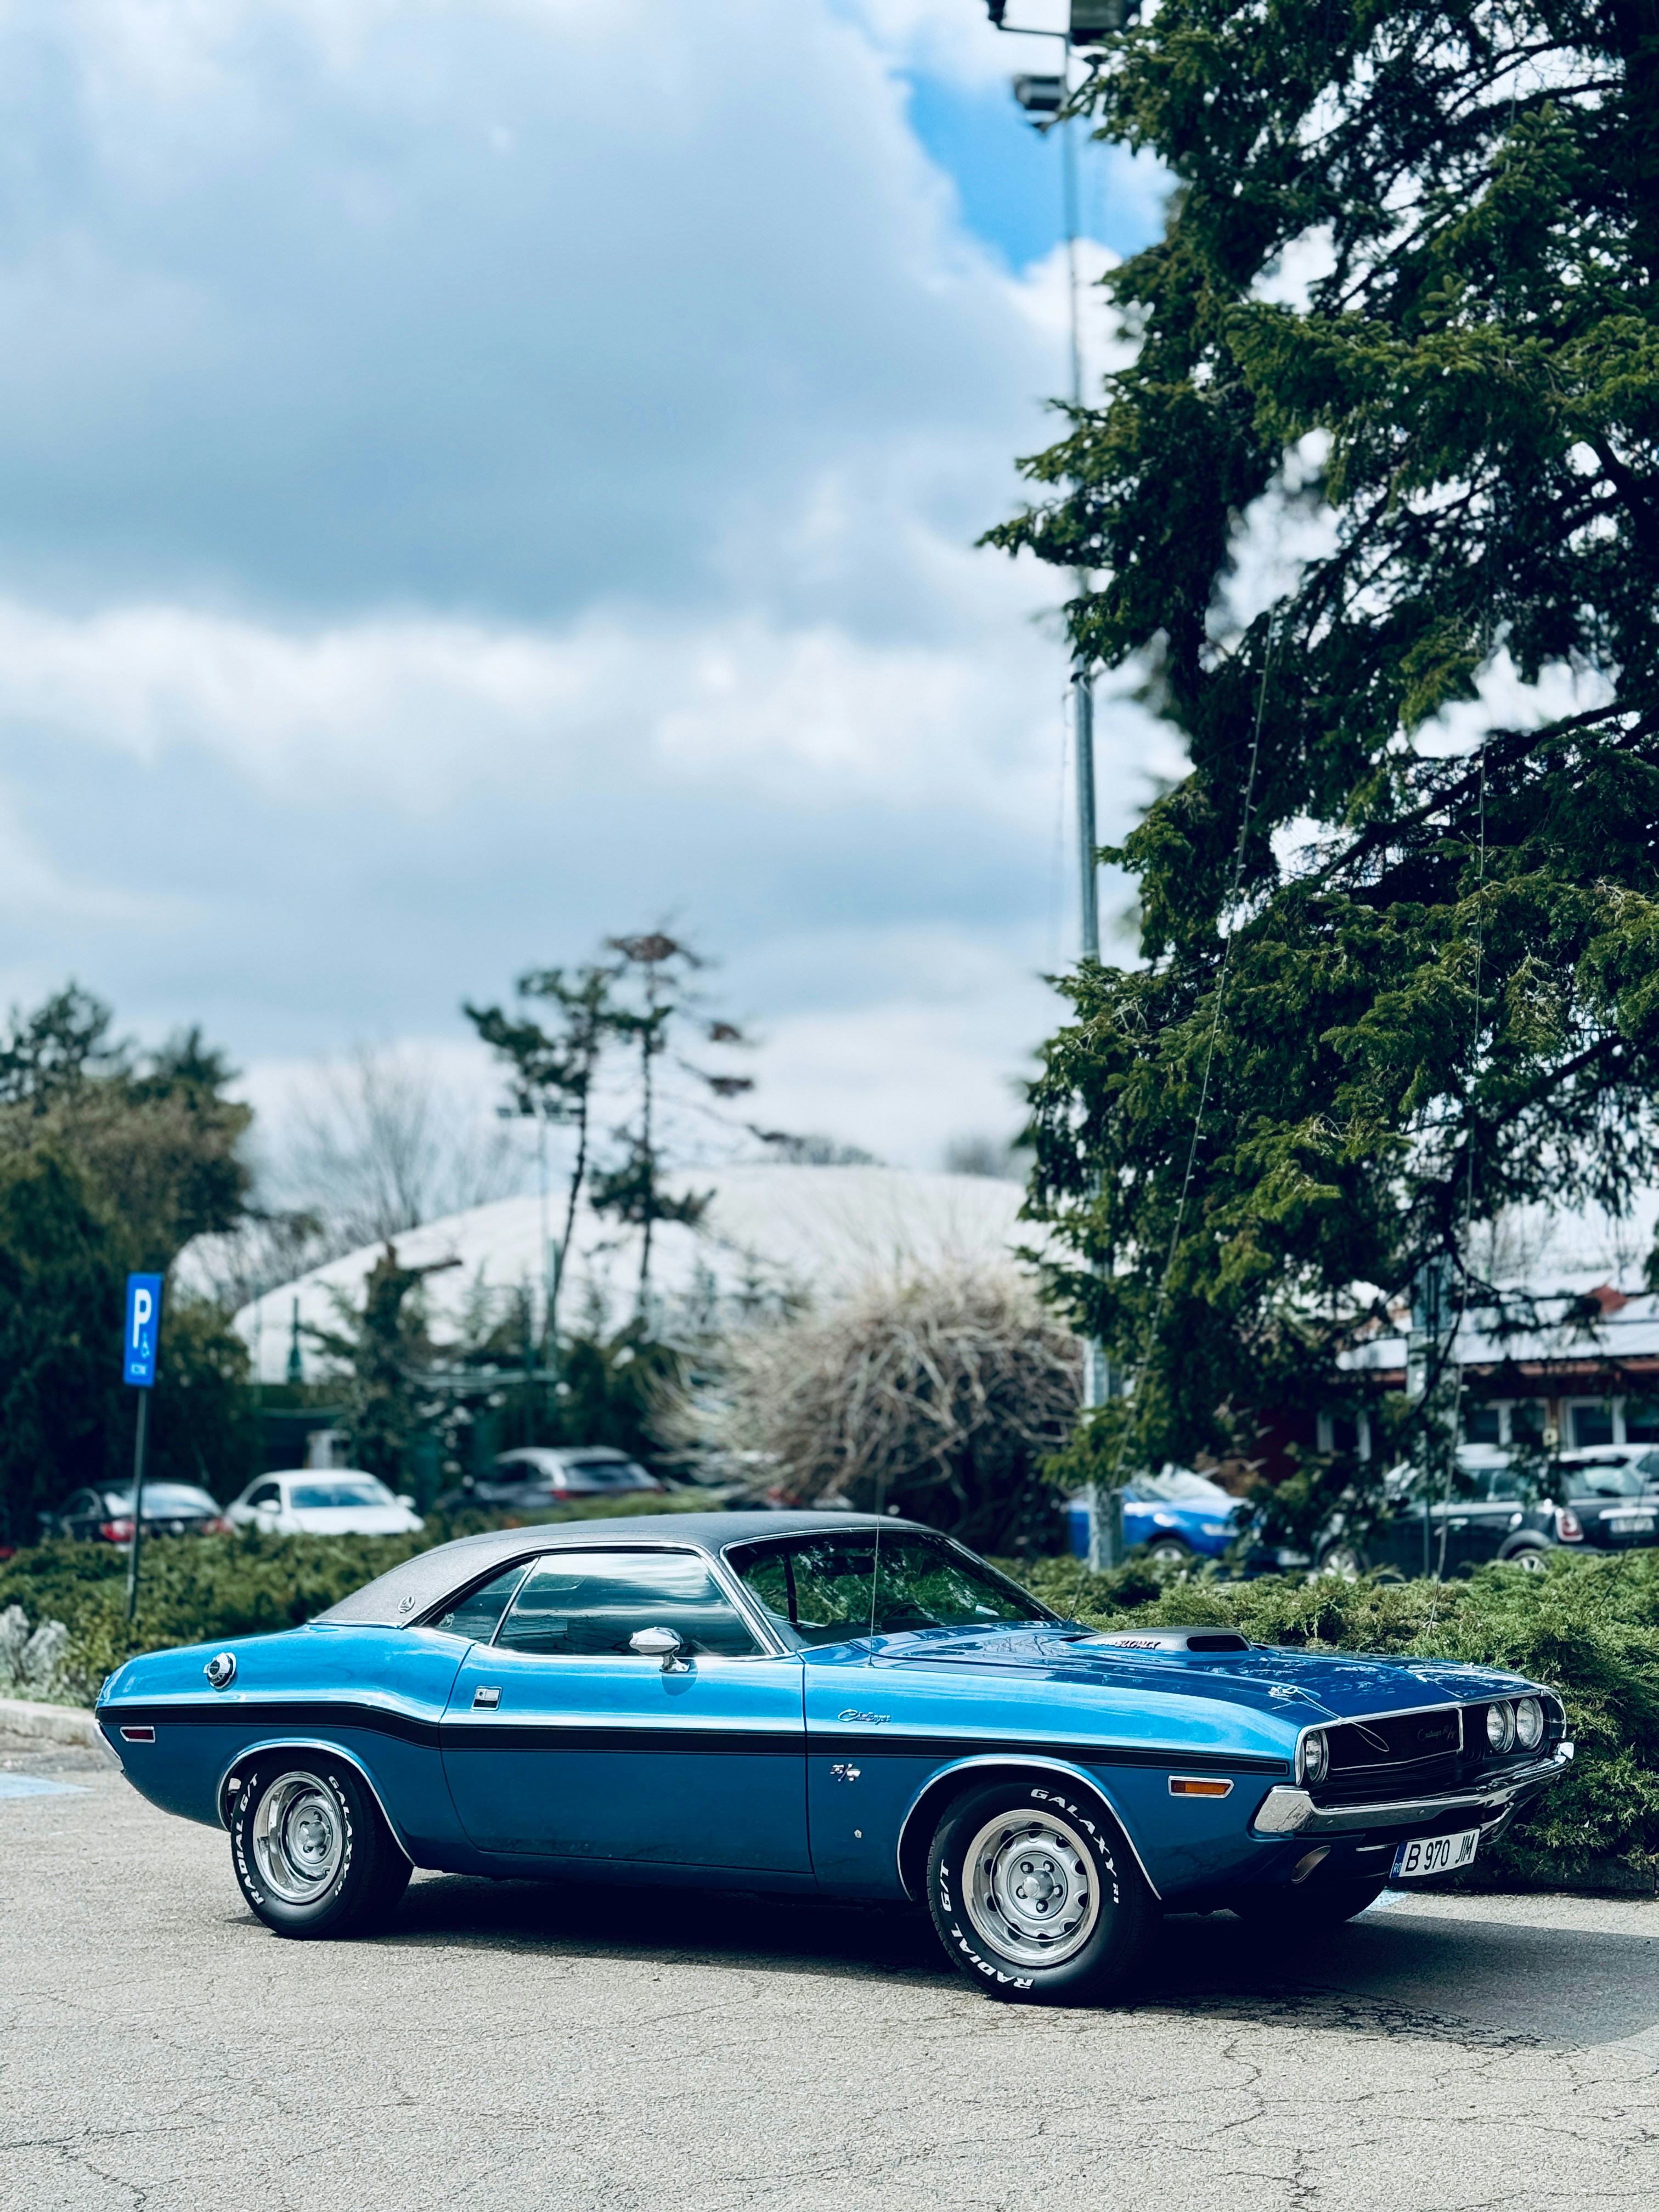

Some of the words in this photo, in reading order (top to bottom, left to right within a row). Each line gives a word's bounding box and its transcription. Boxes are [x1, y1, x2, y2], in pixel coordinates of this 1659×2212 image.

[133, 1289, 152, 1349] P
[240, 1773, 258, 1812] G/T
[328, 1775, 353, 1878] GALAXY
[1030, 1788, 1117, 1877] GALAXY
[1405, 1844, 1421, 1872] B
[1424, 1839, 1450, 1870] 970
[235, 1819, 266, 1905] RADIAL
[939, 1859, 952, 1912] G/T
[950, 1922, 1035, 1990] RADIAL
